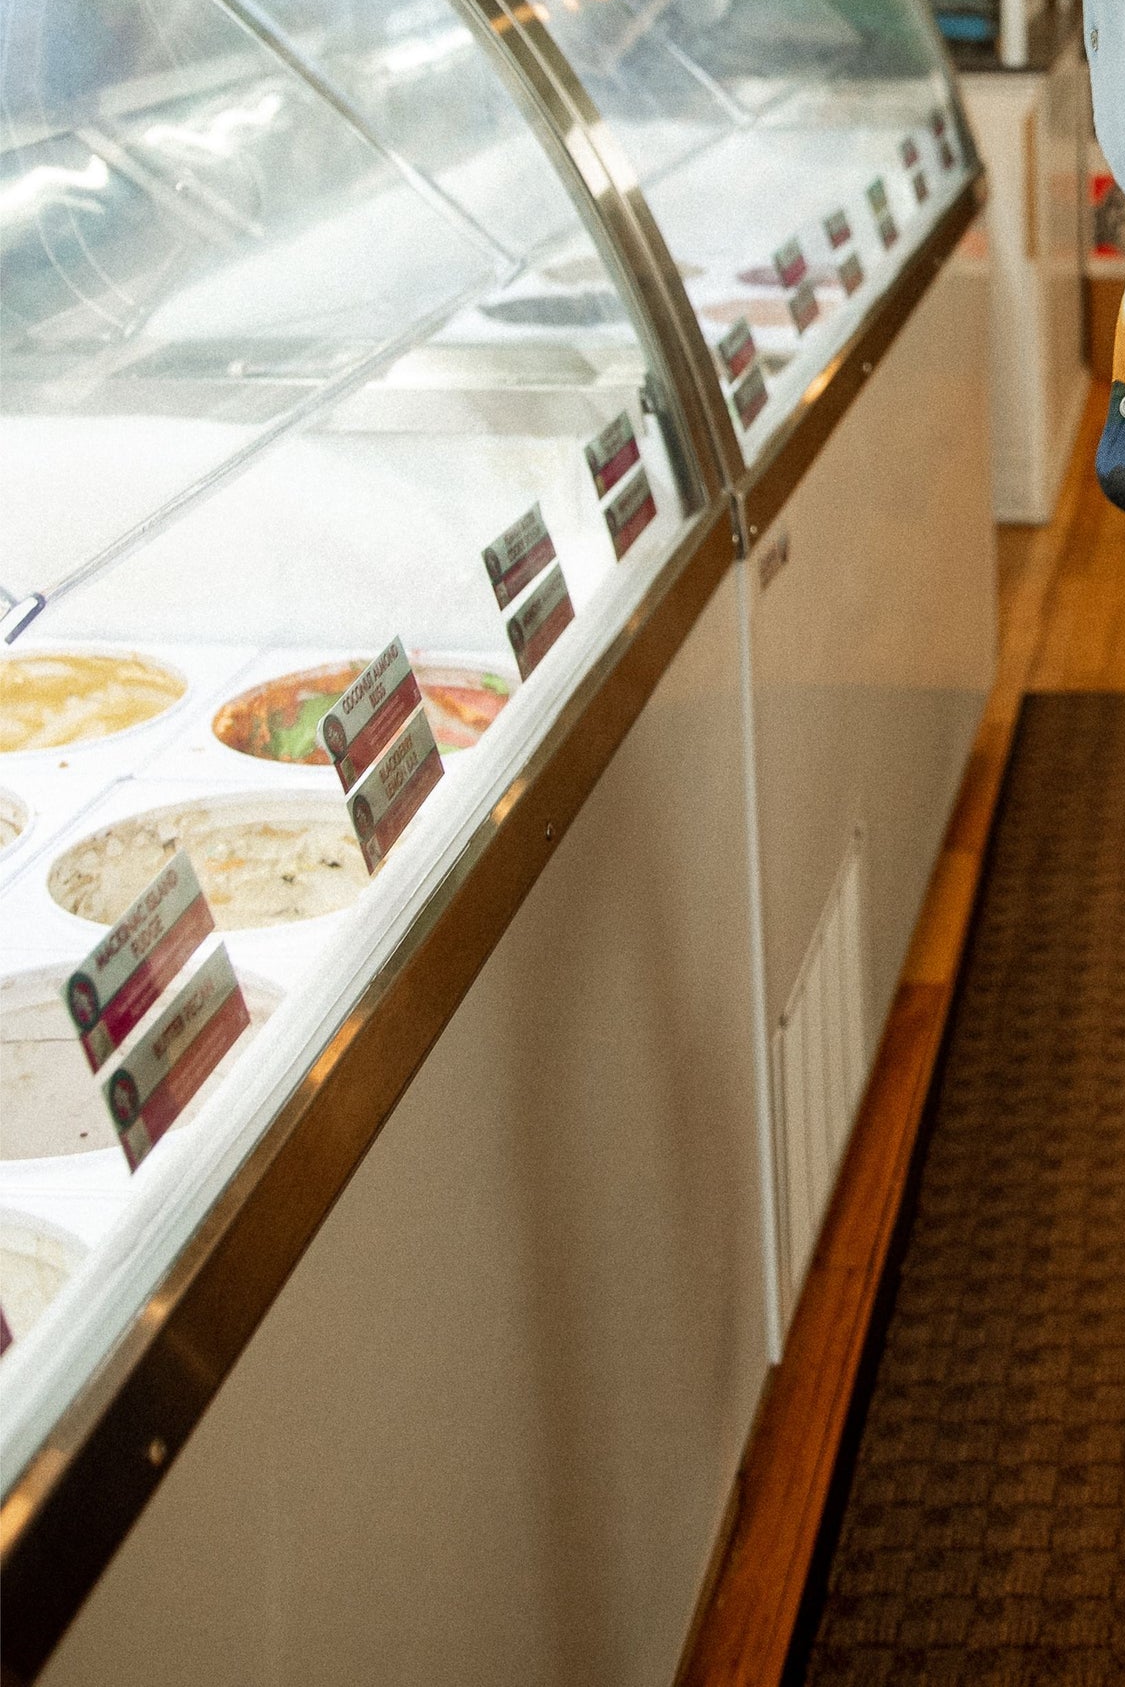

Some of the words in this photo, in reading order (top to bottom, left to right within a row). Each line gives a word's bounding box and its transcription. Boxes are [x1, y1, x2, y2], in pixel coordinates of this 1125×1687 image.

[342, 672, 373, 715] COCONUT
[372, 644, 399, 681] ALMOND
[368, 681, 386, 709] BLISS
[379, 733, 413, 784] BLACKBERRY
